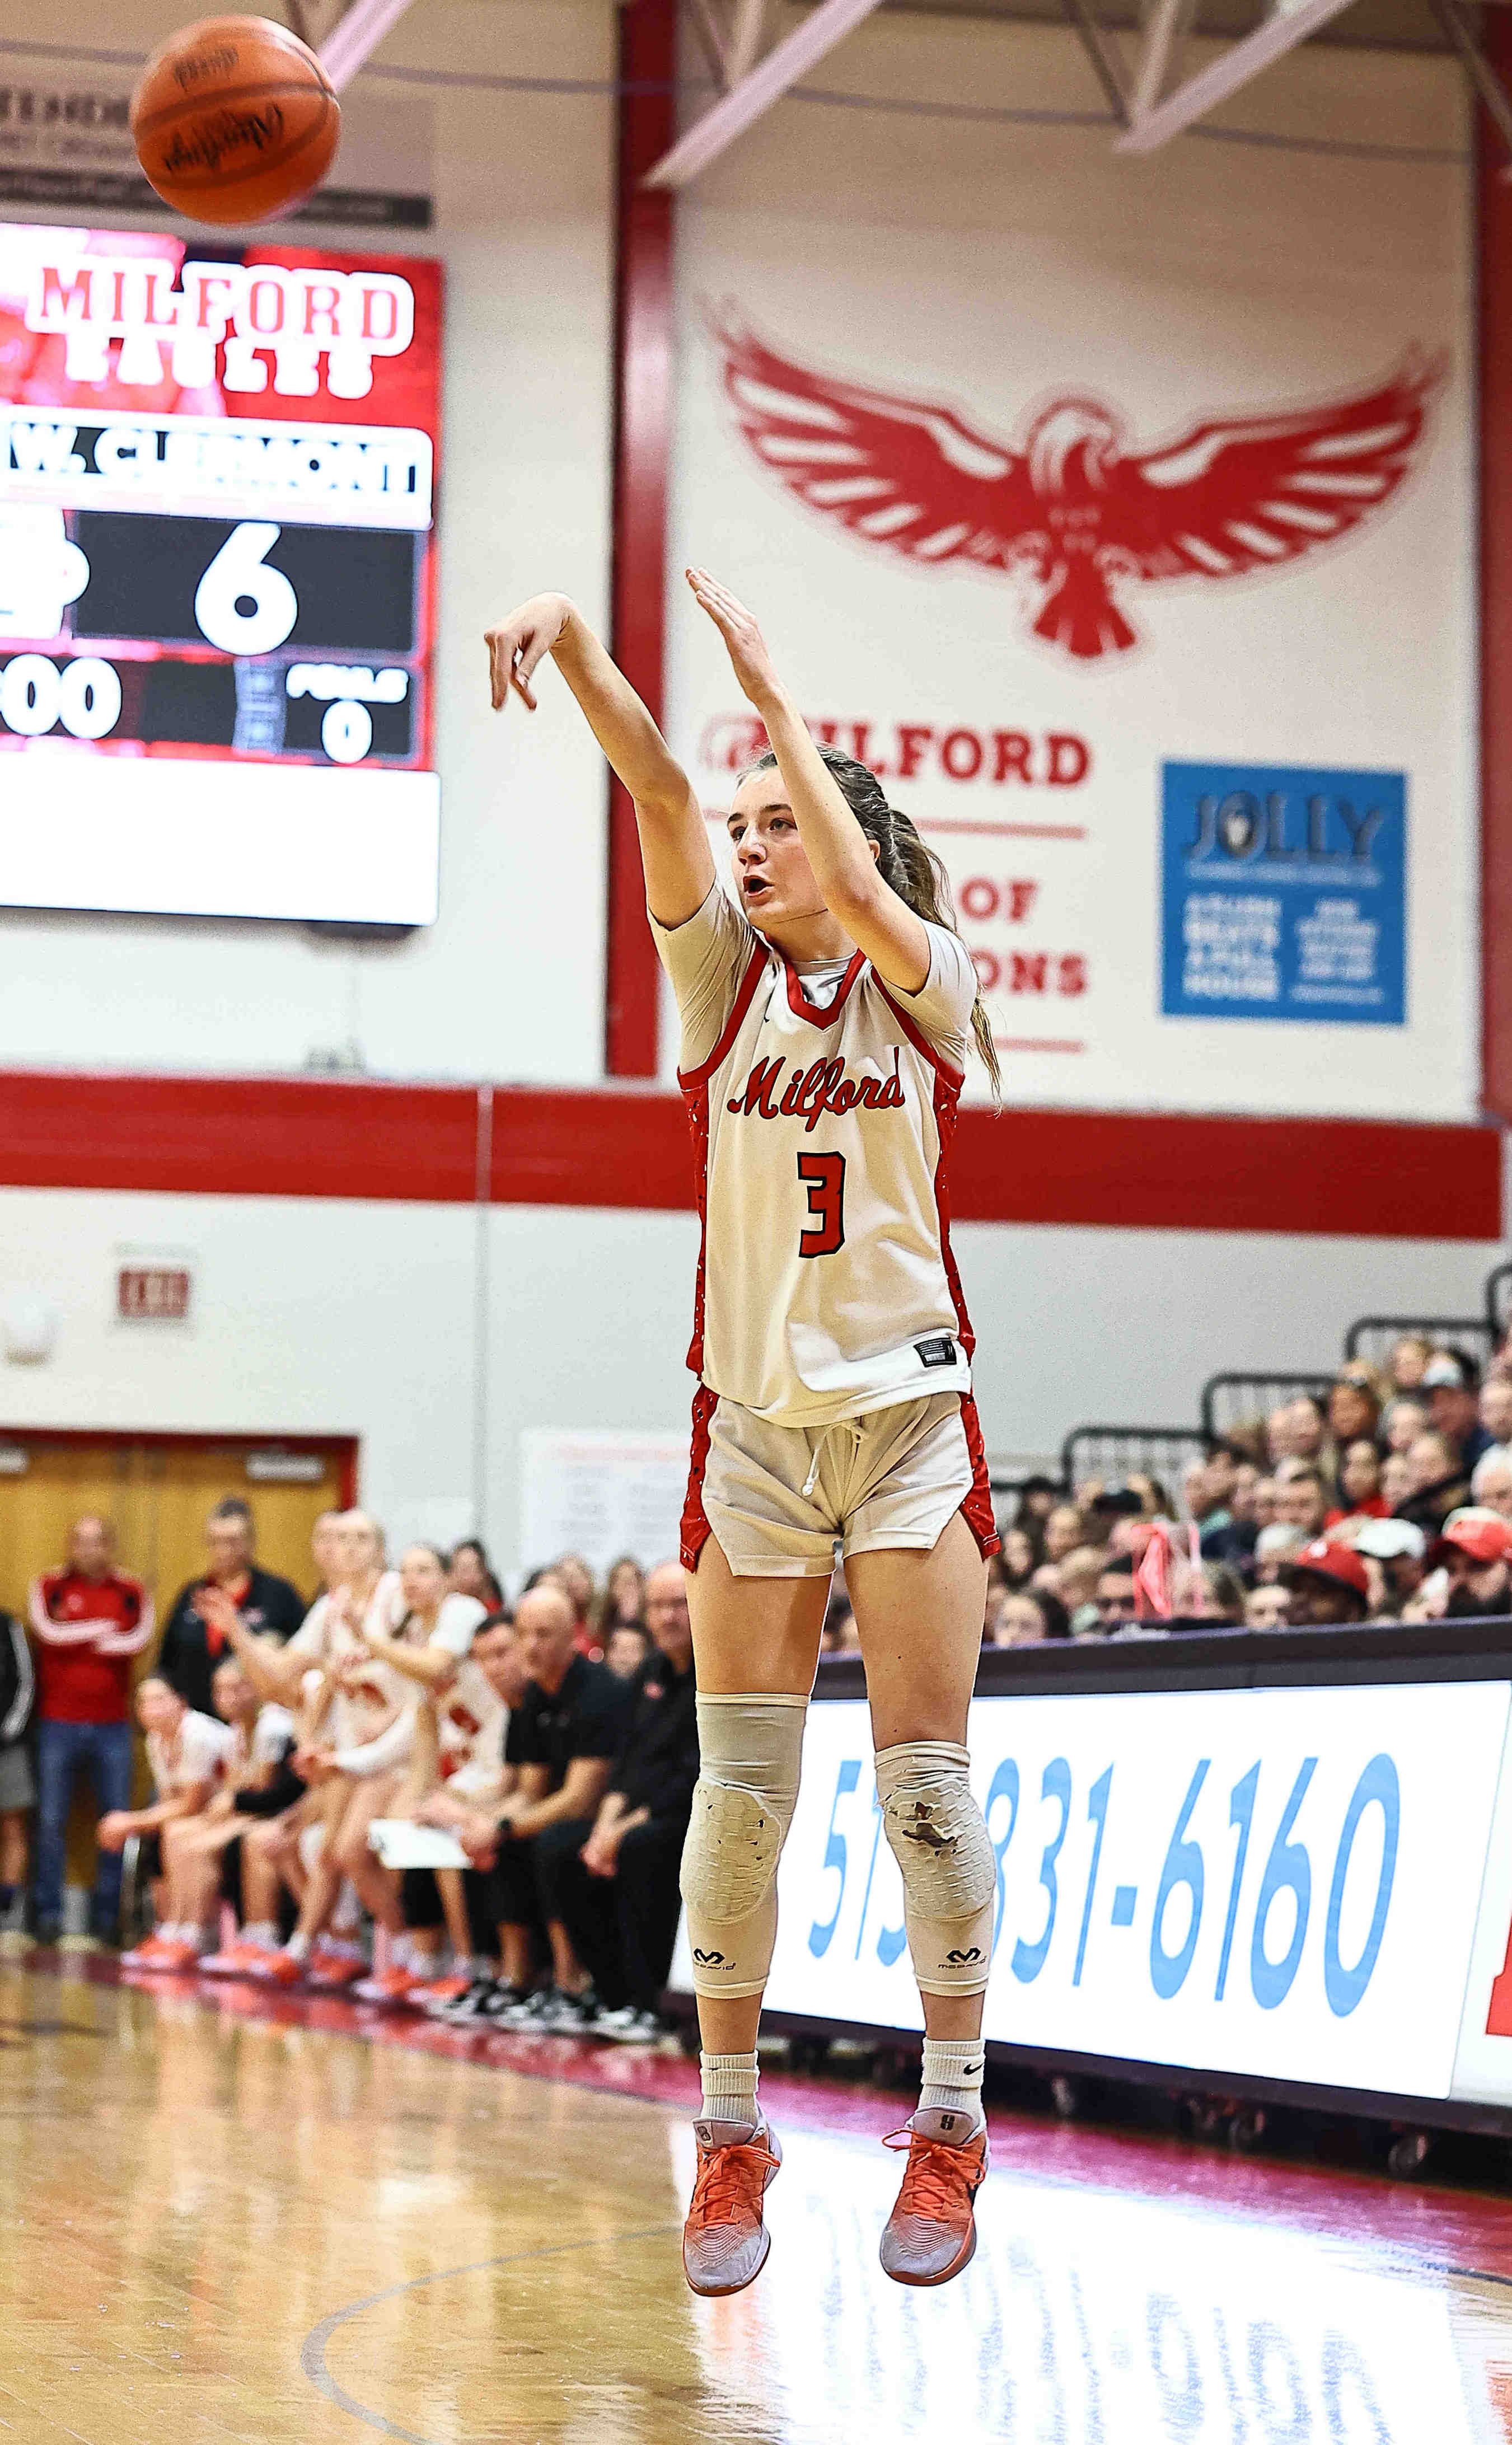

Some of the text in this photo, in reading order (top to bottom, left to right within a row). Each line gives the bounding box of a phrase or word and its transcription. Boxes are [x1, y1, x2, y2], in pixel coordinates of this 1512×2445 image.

[38, 265, 401, 341] MILFORD
[194, 521, 298, 656] 6
[321, 700, 373, 765] 0
[751, 716, 1090, 786] LFORD
[1181, 789, 1387, 863] JOLLY
[958, 874, 1037, 924] OF
[727, 1045, 906, 1132] Milford
[797, 1151, 846, 1259] 3
[808, 1753, 1401, 2018] 51831-6160
